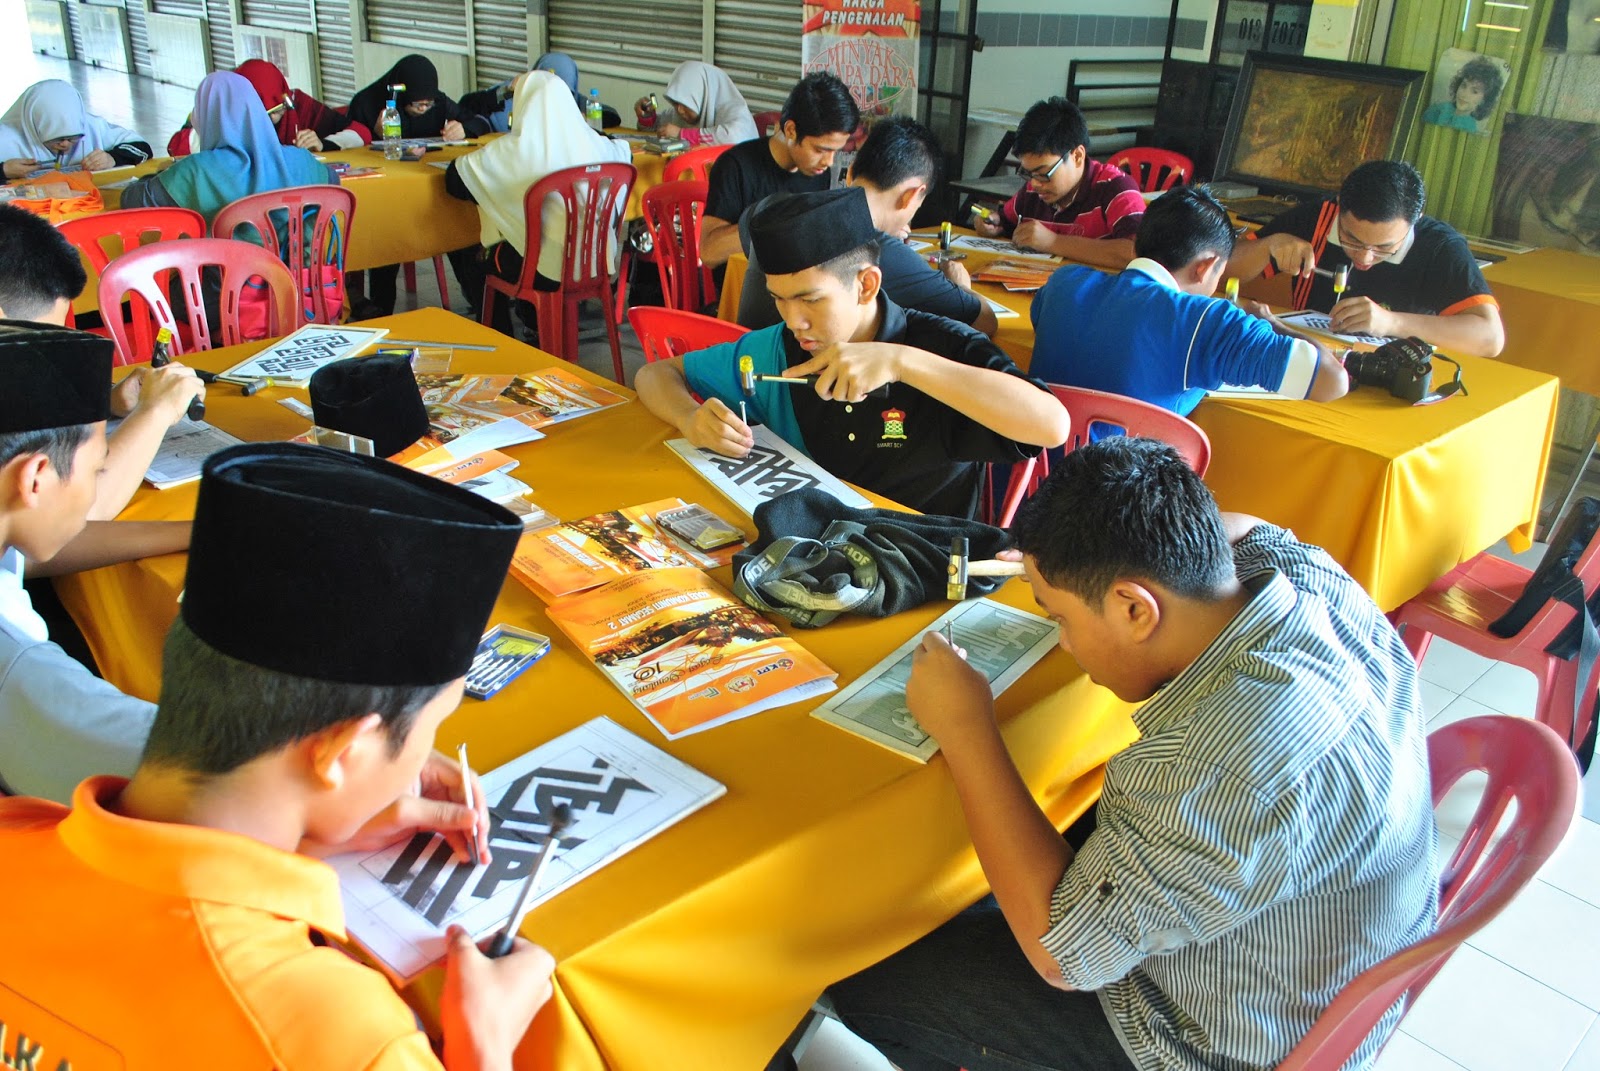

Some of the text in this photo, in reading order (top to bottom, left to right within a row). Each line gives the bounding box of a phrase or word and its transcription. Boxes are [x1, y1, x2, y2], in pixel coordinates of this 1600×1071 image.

[822, 11, 905, 26] PENGENALAN
[827, 38, 893, 69] MINYAK
[870, 65, 916, 88] DARA
[849, 84, 879, 110] SLI
[1401, 345, 1427, 374] Cnon
[607, 622, 618, 631] 2
[618, 605, 655, 626] SEGAMAT
